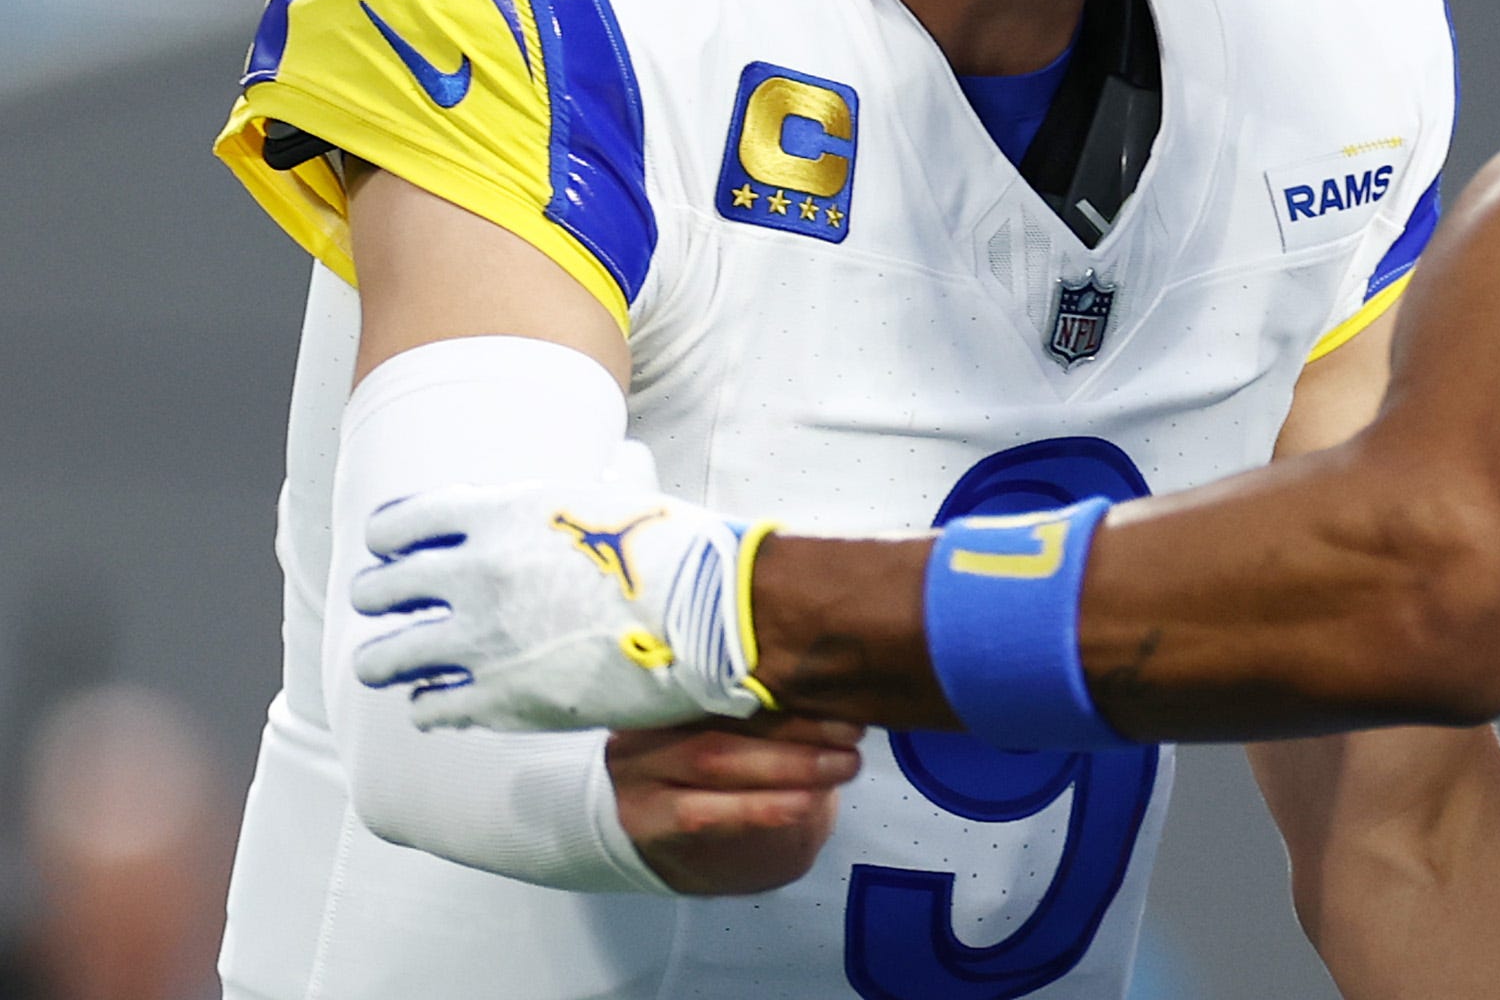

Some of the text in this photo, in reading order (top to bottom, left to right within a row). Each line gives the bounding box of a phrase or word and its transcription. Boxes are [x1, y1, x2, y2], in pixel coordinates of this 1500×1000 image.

[738, 76, 853, 198] C
[1284, 165, 1393, 222] RAMS
[1055, 316, 1098, 354] NFL
